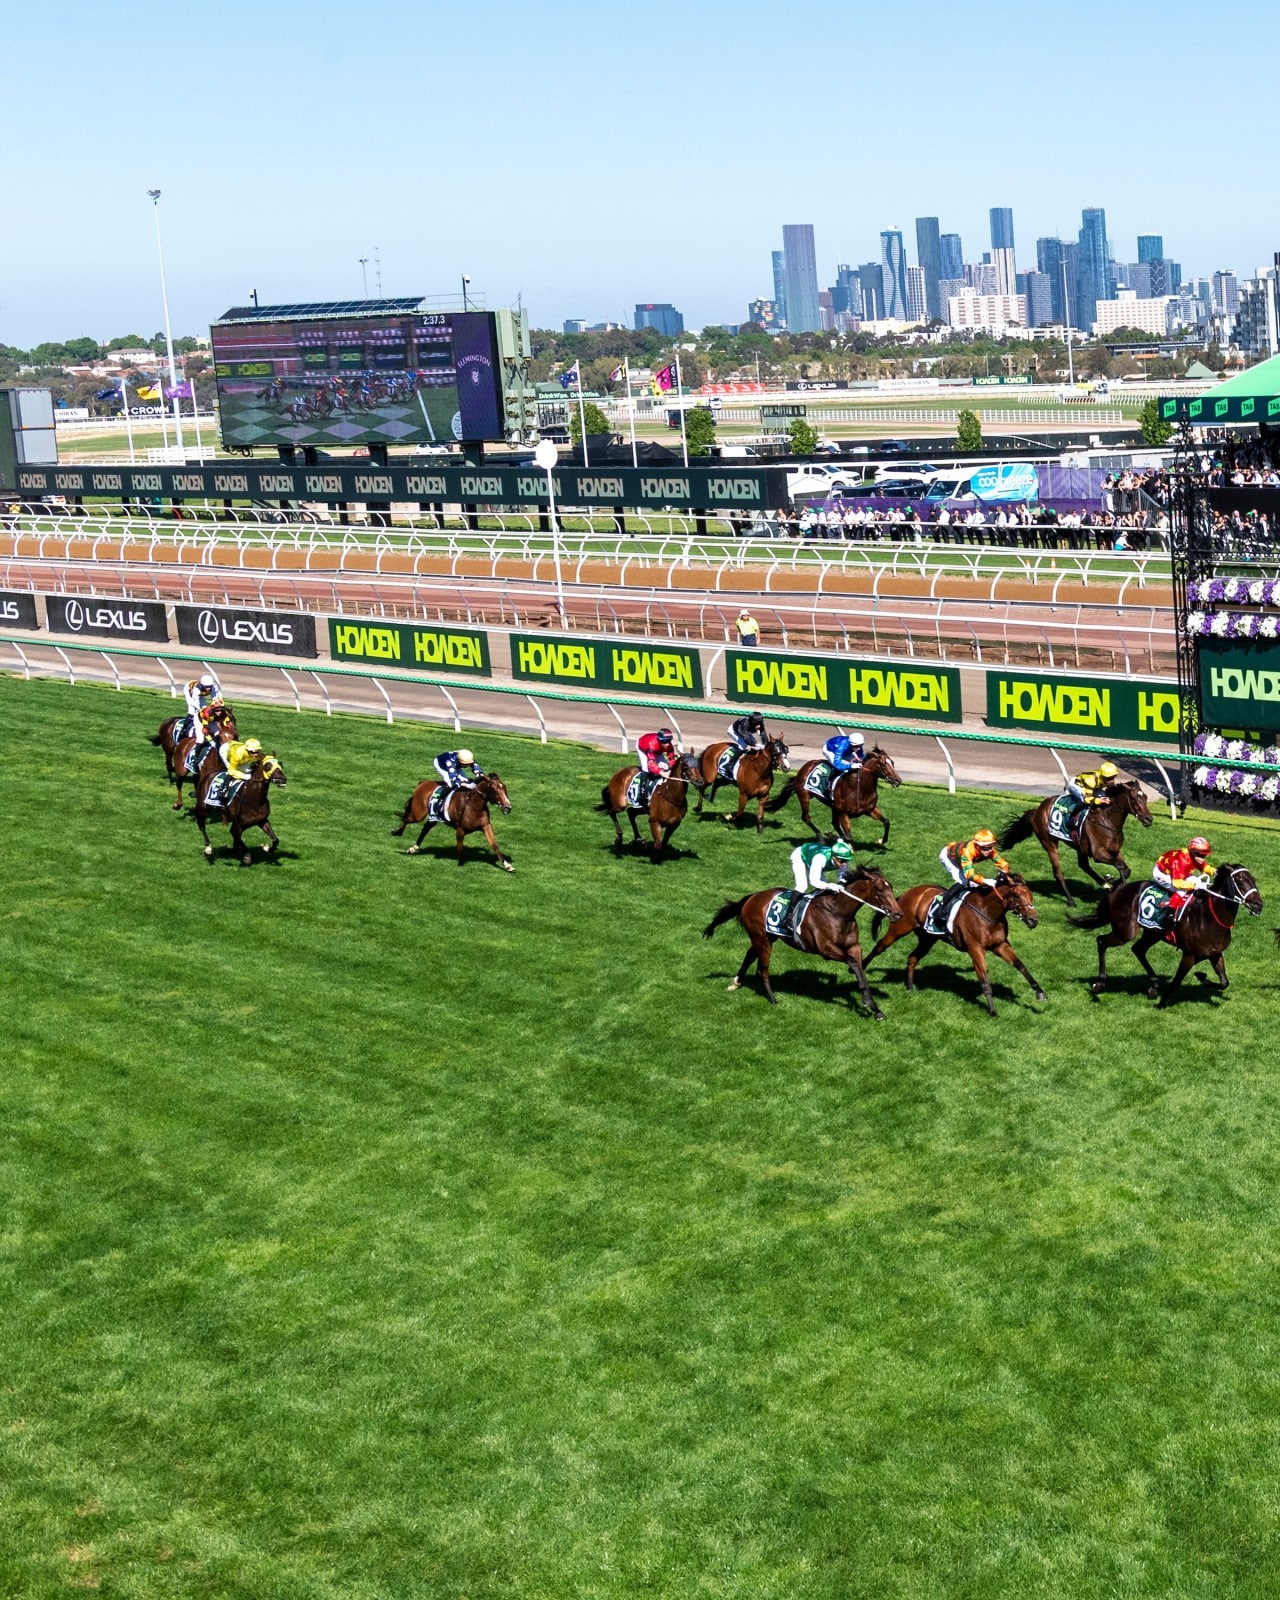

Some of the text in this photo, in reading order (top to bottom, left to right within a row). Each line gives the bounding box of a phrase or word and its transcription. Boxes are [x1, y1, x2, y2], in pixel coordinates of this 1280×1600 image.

[423, 315, 445, 325] 2:37.3
[457, 354, 491, 368] FLEMINGTON
[131, 406, 170, 415] CROWN
[1165, 405, 1176, 413] TAB
[1190, 404, 1201, 412] TAB
[1216, 403, 1227, 412] TAB
[1243, 402, 1254, 411] TAB
[1269, 402, 1280, 410] TAB
[20, 474, 47, 489] HOWDEN
[55, 474, 84, 489] HOWDEN
[92, 475, 122, 490] HOWDEN
[131, 475, 162, 490] HOWDEN
[172, 475, 204, 490] HOWDEN
[214, 476, 248, 492] HOWDEN
[259, 476, 294, 492] HOWDEN
[306, 476, 343, 493] HOWDEN
[354, 476, 393, 493] HOWDEN
[406, 477, 446, 494] HOWDEN
[461, 477, 503, 495] HOWDEN
[577, 478, 624, 497] HOWDEN
[640, 479, 690, 498] HOWDEN
[708, 479, 760, 499] HOWDEN
[86, 608, 147, 631] LEXUS
[222, 619, 293, 645] LEXUS
[335, 625, 482, 668] HOWDEN HOWDEN
[518, 641, 693, 689] HOWDEN HOWDEN
[735, 658, 949, 712] HOWDEN HOWDEN
[999, 680, 1110, 727] HOWDEN
[719, 753, 730, 770] 2
[810, 769, 823, 787] 5
[1050, 809, 1063, 830] 9
[767, 902, 783, 927] 3
[1141, 895, 1156, 919] 6
